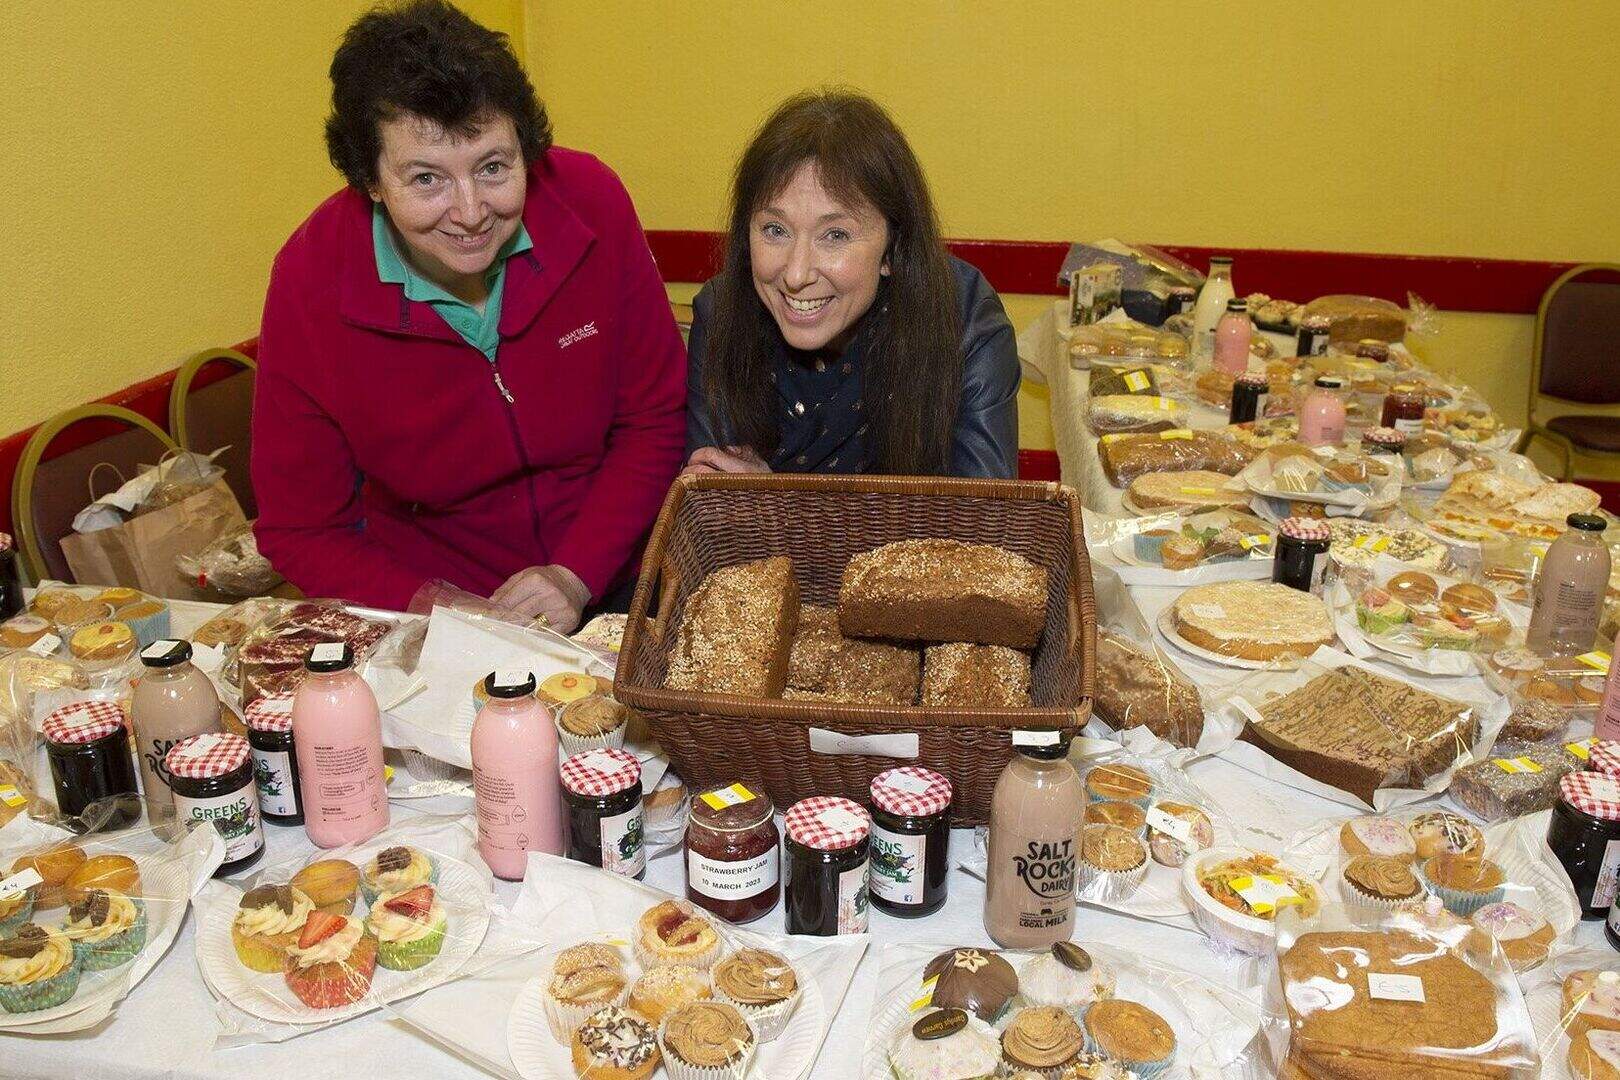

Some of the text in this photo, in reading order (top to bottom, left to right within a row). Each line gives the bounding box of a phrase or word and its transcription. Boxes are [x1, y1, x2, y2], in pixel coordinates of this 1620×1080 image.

[192, 797, 247, 820] GREENS
[1026, 839, 1072, 861] SALT
[700, 858, 769, 876] STRAWBERRY JAM
[1012, 854, 1076, 880] ROCK
[702, 877, 761, 890] 10 MARCH 2023
[1041, 877, 1070, 893] DAIRY
[1019, 920, 1045, 929] LOCAL
[1045, 914, 1068, 928] MILK
